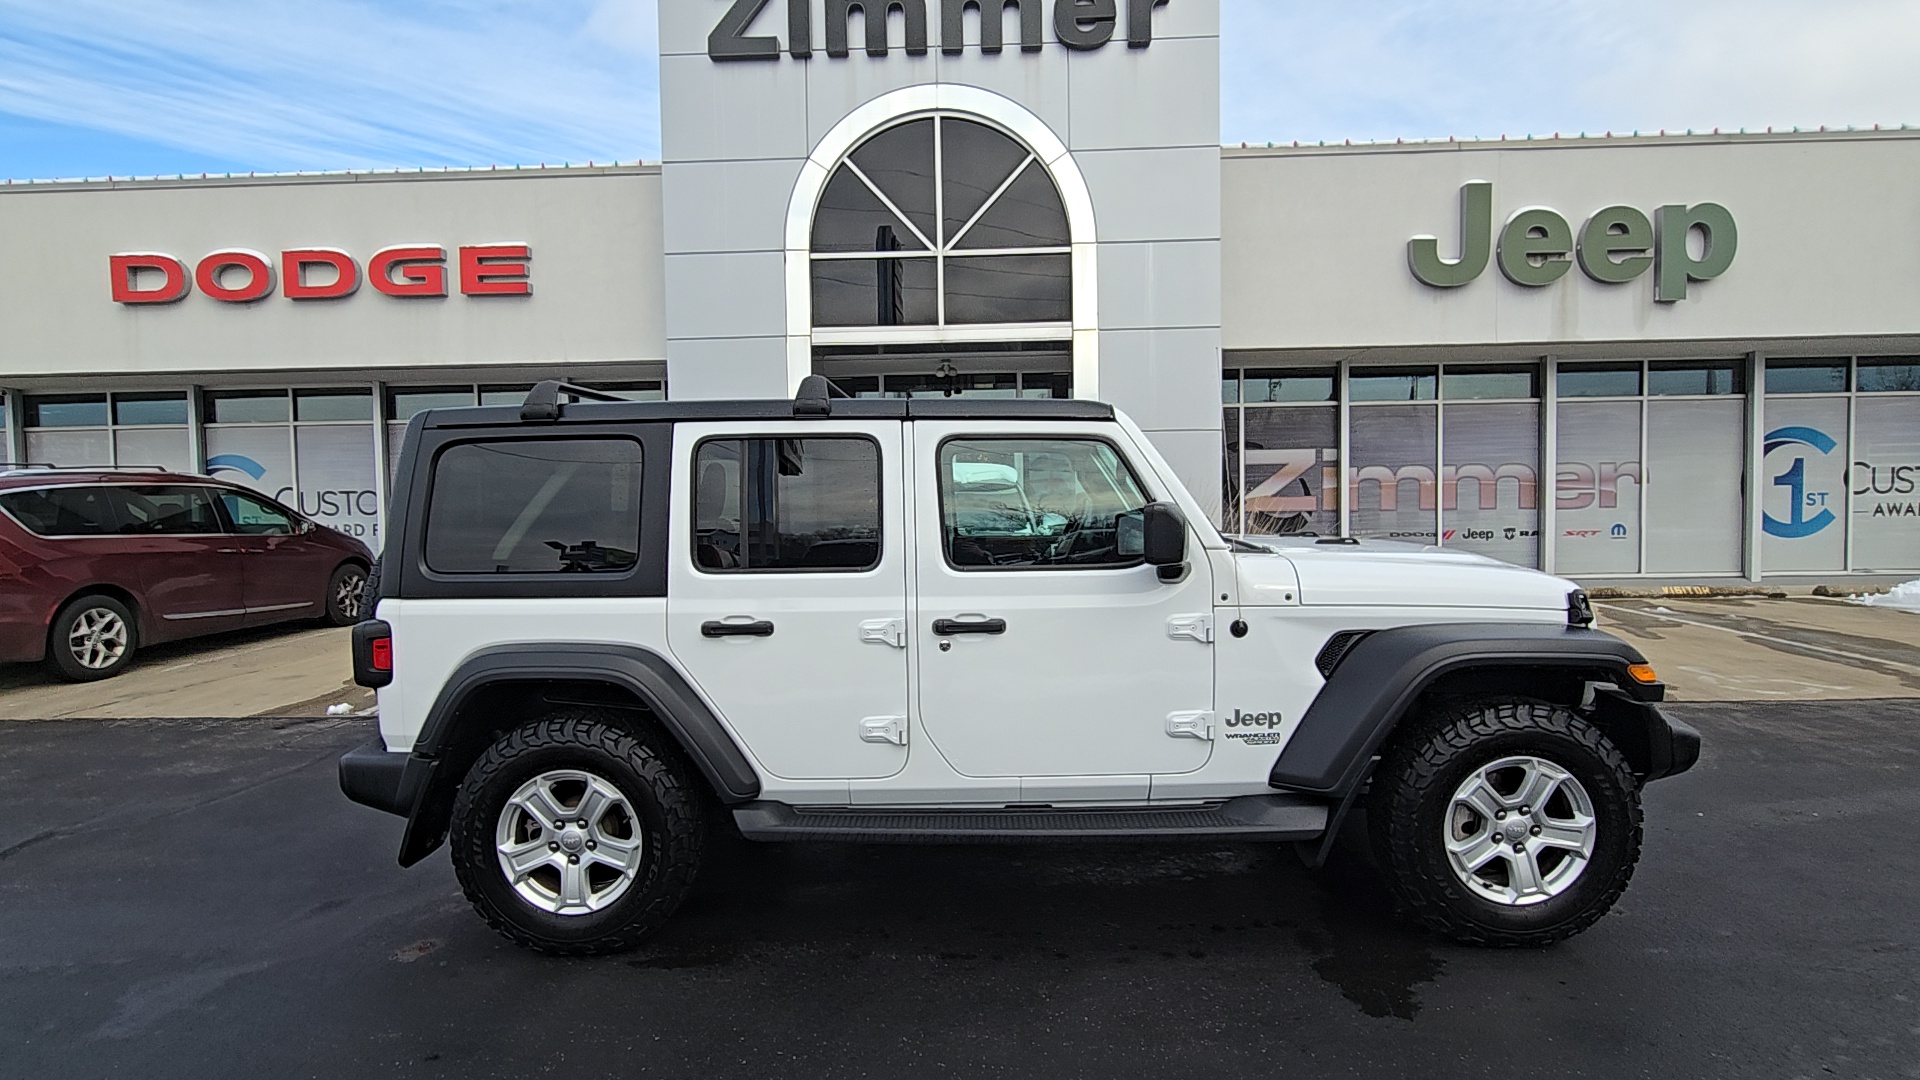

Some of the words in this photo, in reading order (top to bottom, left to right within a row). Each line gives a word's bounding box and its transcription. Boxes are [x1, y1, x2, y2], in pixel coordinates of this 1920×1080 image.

[708, 0, 1170, 61] Zimmer
[1407, 179, 1738, 303] Jeep
[109, 241, 533, 303] DODGE
[1245, 448, 1650, 512] Zimmer
[1843, 461, 1920, 495] CUS
[1872, 502, 1920, 517] AWA
[1462, 527, 1494, 541] Jeep
[1563, 529, 1602, 538] SRT
[1224, 708, 1282, 729] Jeep
